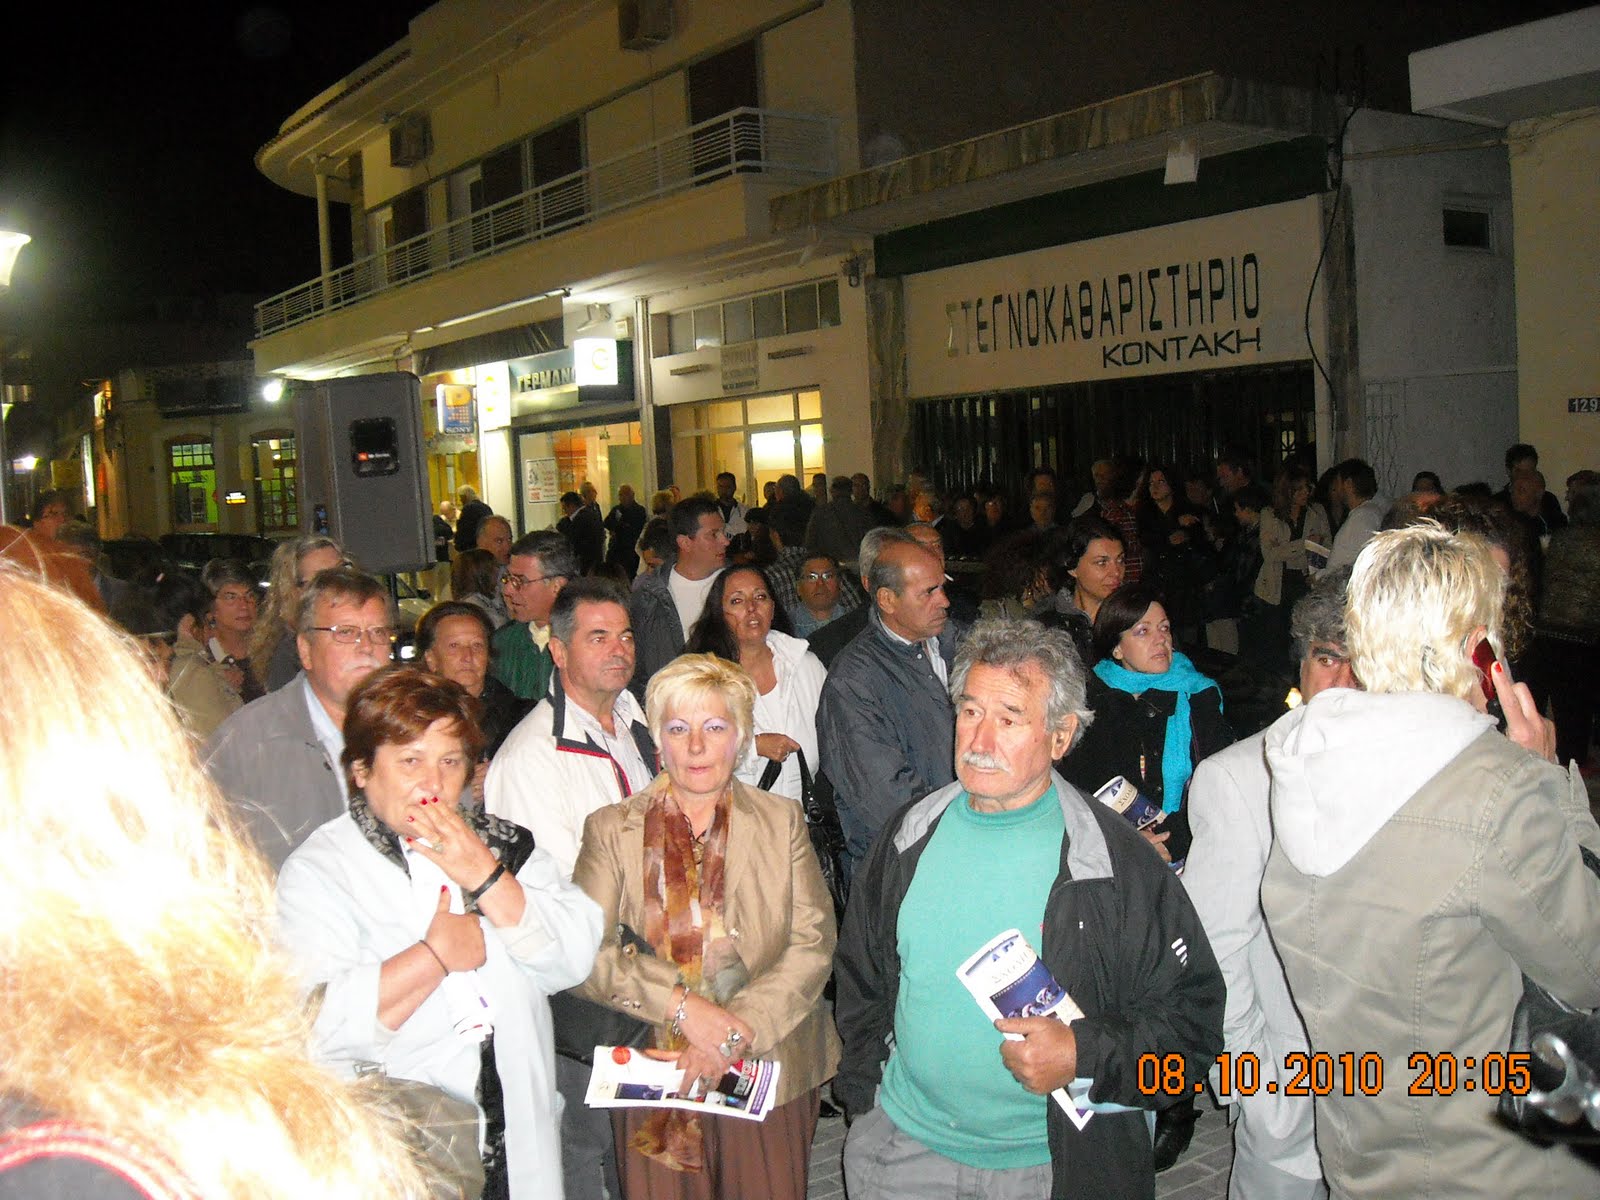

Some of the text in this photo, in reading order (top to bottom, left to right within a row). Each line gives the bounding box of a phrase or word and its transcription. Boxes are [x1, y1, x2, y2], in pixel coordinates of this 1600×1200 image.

[945, 252, 1260, 357] ΣΤΕΓΝΟΚΑΘΑΡΙΣΤΗΡΙΟ
[1103, 327, 1261, 368] ΚΟΝΤΑΚΗ
[1572, 398, 1598, 412] 129
